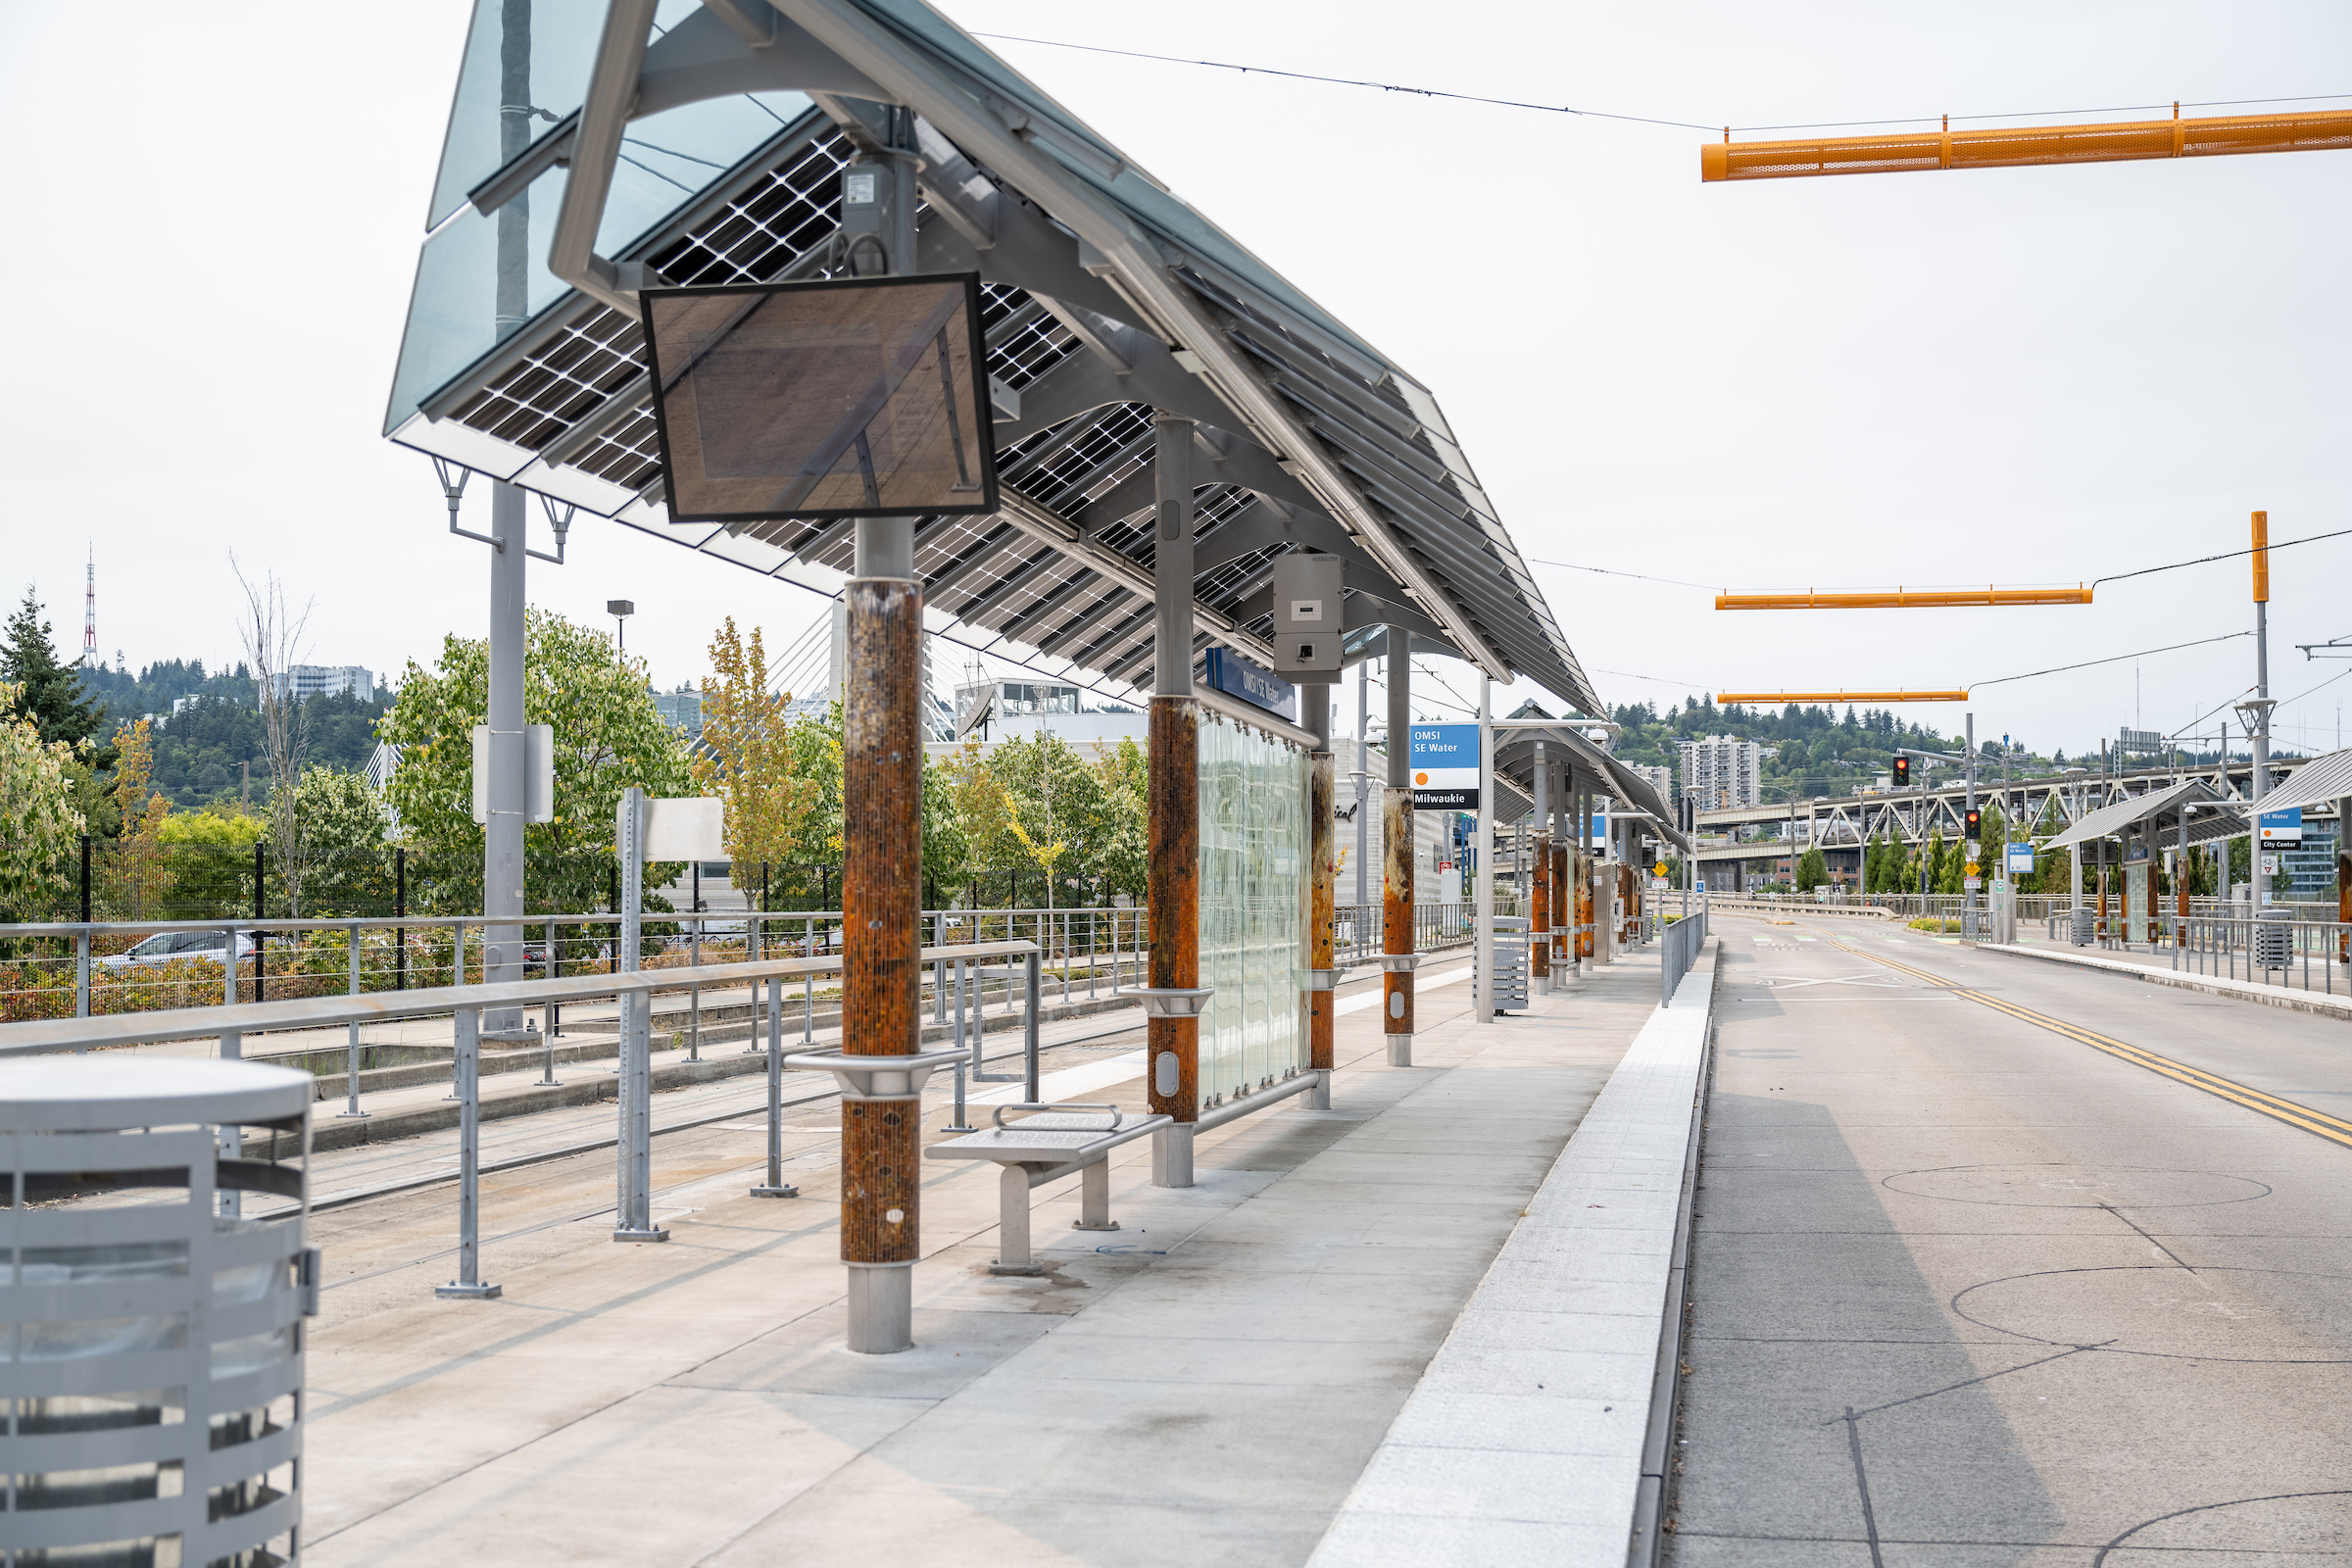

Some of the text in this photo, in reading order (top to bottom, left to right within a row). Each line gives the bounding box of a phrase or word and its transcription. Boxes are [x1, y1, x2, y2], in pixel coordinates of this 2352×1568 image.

[1265, 680, 1279, 705] Water
[1414, 731, 1441, 740] OMSI
[1414, 743, 1457, 753] SE Water
[1414, 793, 1465, 804] Milwaukie
